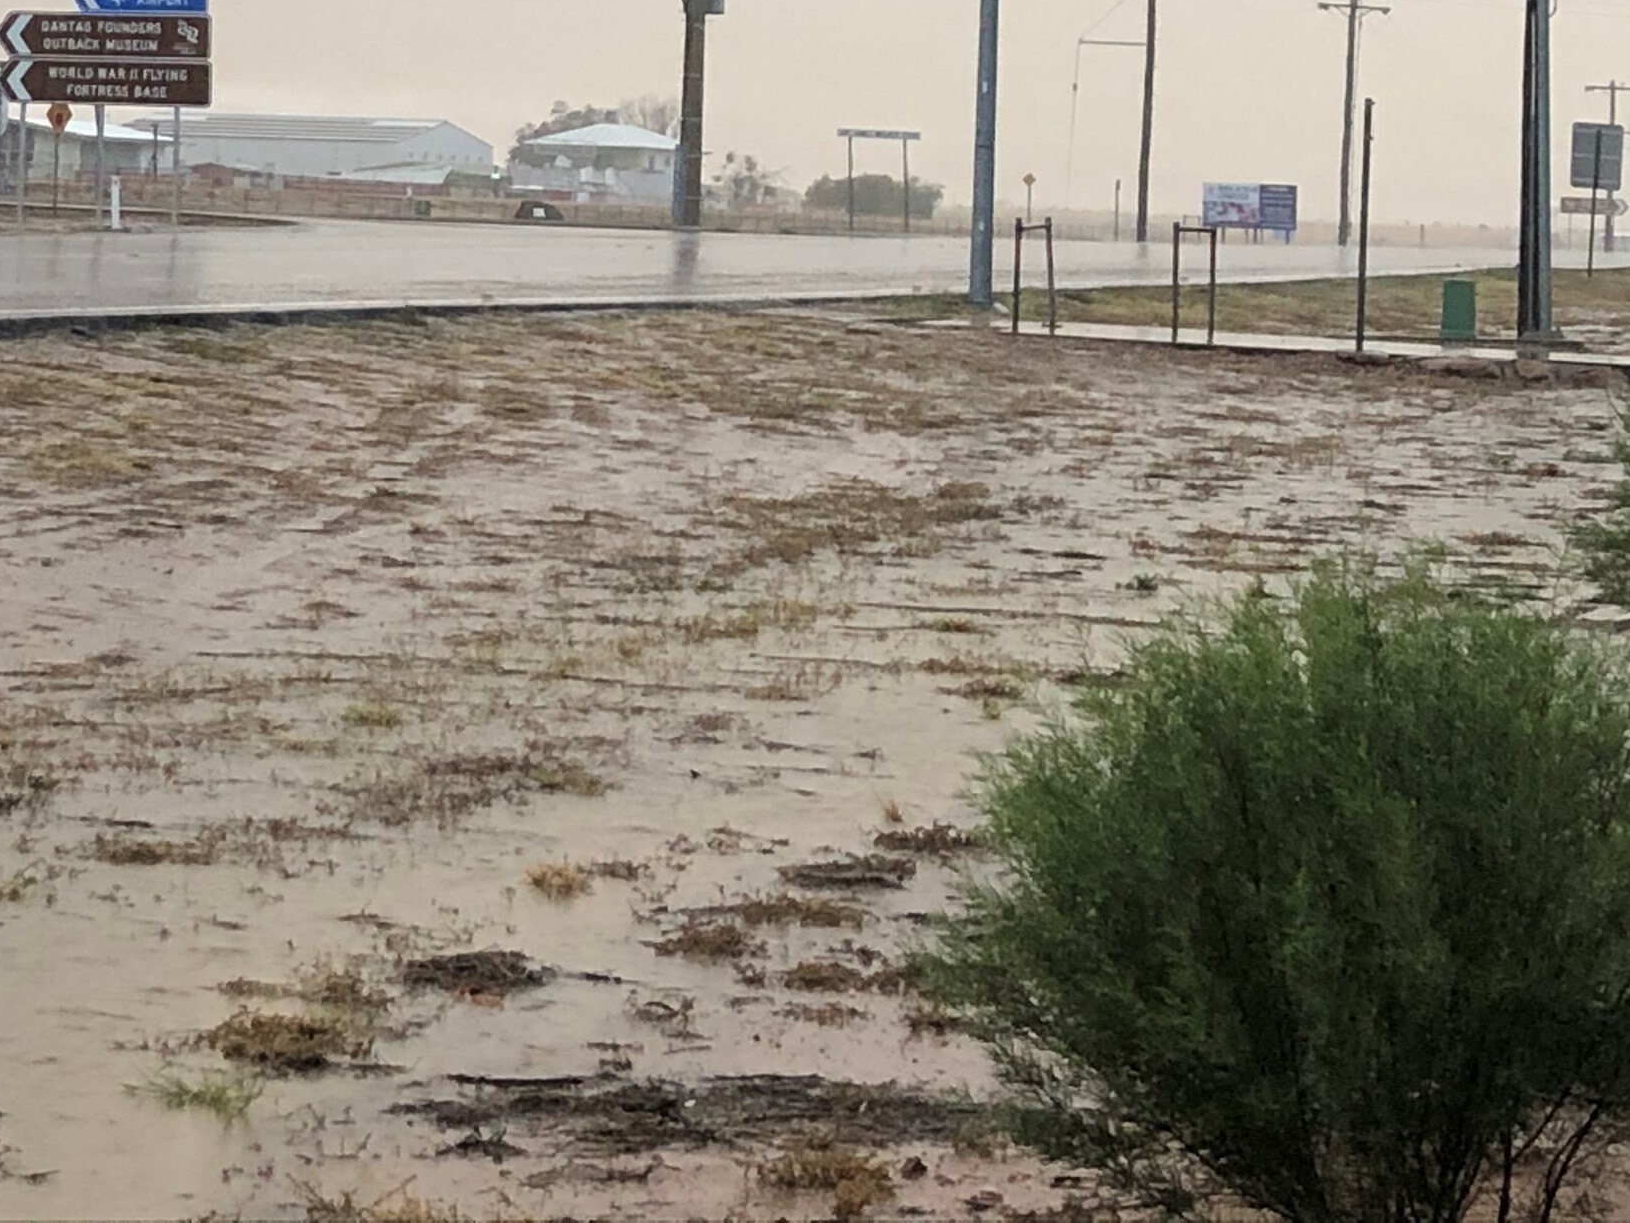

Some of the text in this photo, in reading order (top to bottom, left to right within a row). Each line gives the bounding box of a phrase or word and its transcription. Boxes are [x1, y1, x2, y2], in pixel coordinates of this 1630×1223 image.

[40, 20, 162, 35] QANTAS FOUNDERS
[42, 38, 100, 51] OUTBACK
[105, 39, 158, 52] MUSEUM
[48, 66, 94, 79] WORLD
[97, 67, 126, 80] WAR
[142, 69, 188, 82] FLYING
[66, 85, 168, 98] FORTRESS BASE
